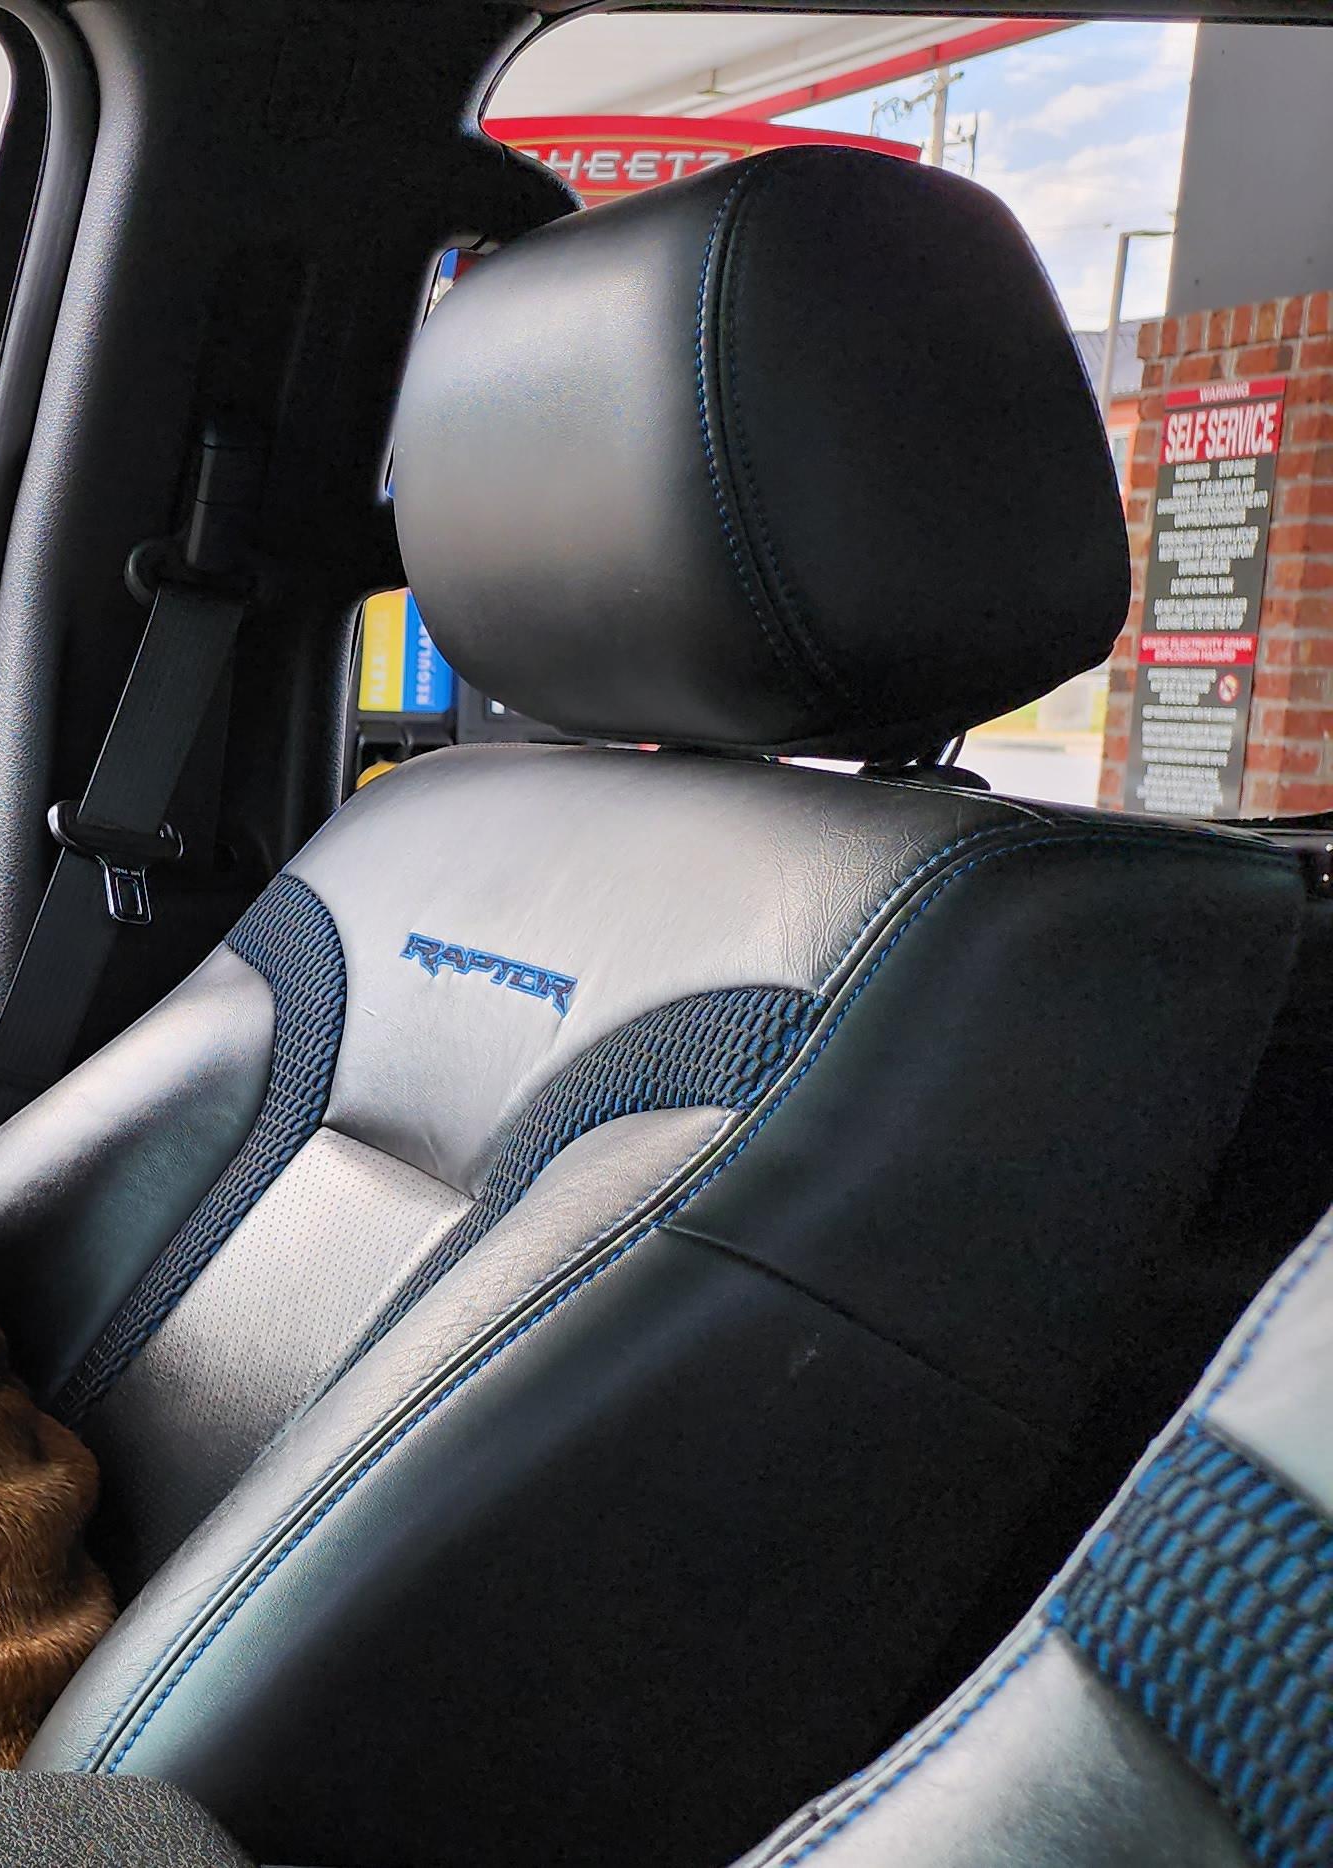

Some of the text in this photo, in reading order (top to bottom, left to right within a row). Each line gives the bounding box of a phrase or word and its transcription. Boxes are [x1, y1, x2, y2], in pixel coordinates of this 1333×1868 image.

[521, 149, 730, 181] HEETZ
[1199, 381, 1250, 402] WARNING
[1165, 402, 1277, 464] SELF SERVICE
[399, 932, 578, 1018] RAPTOR
